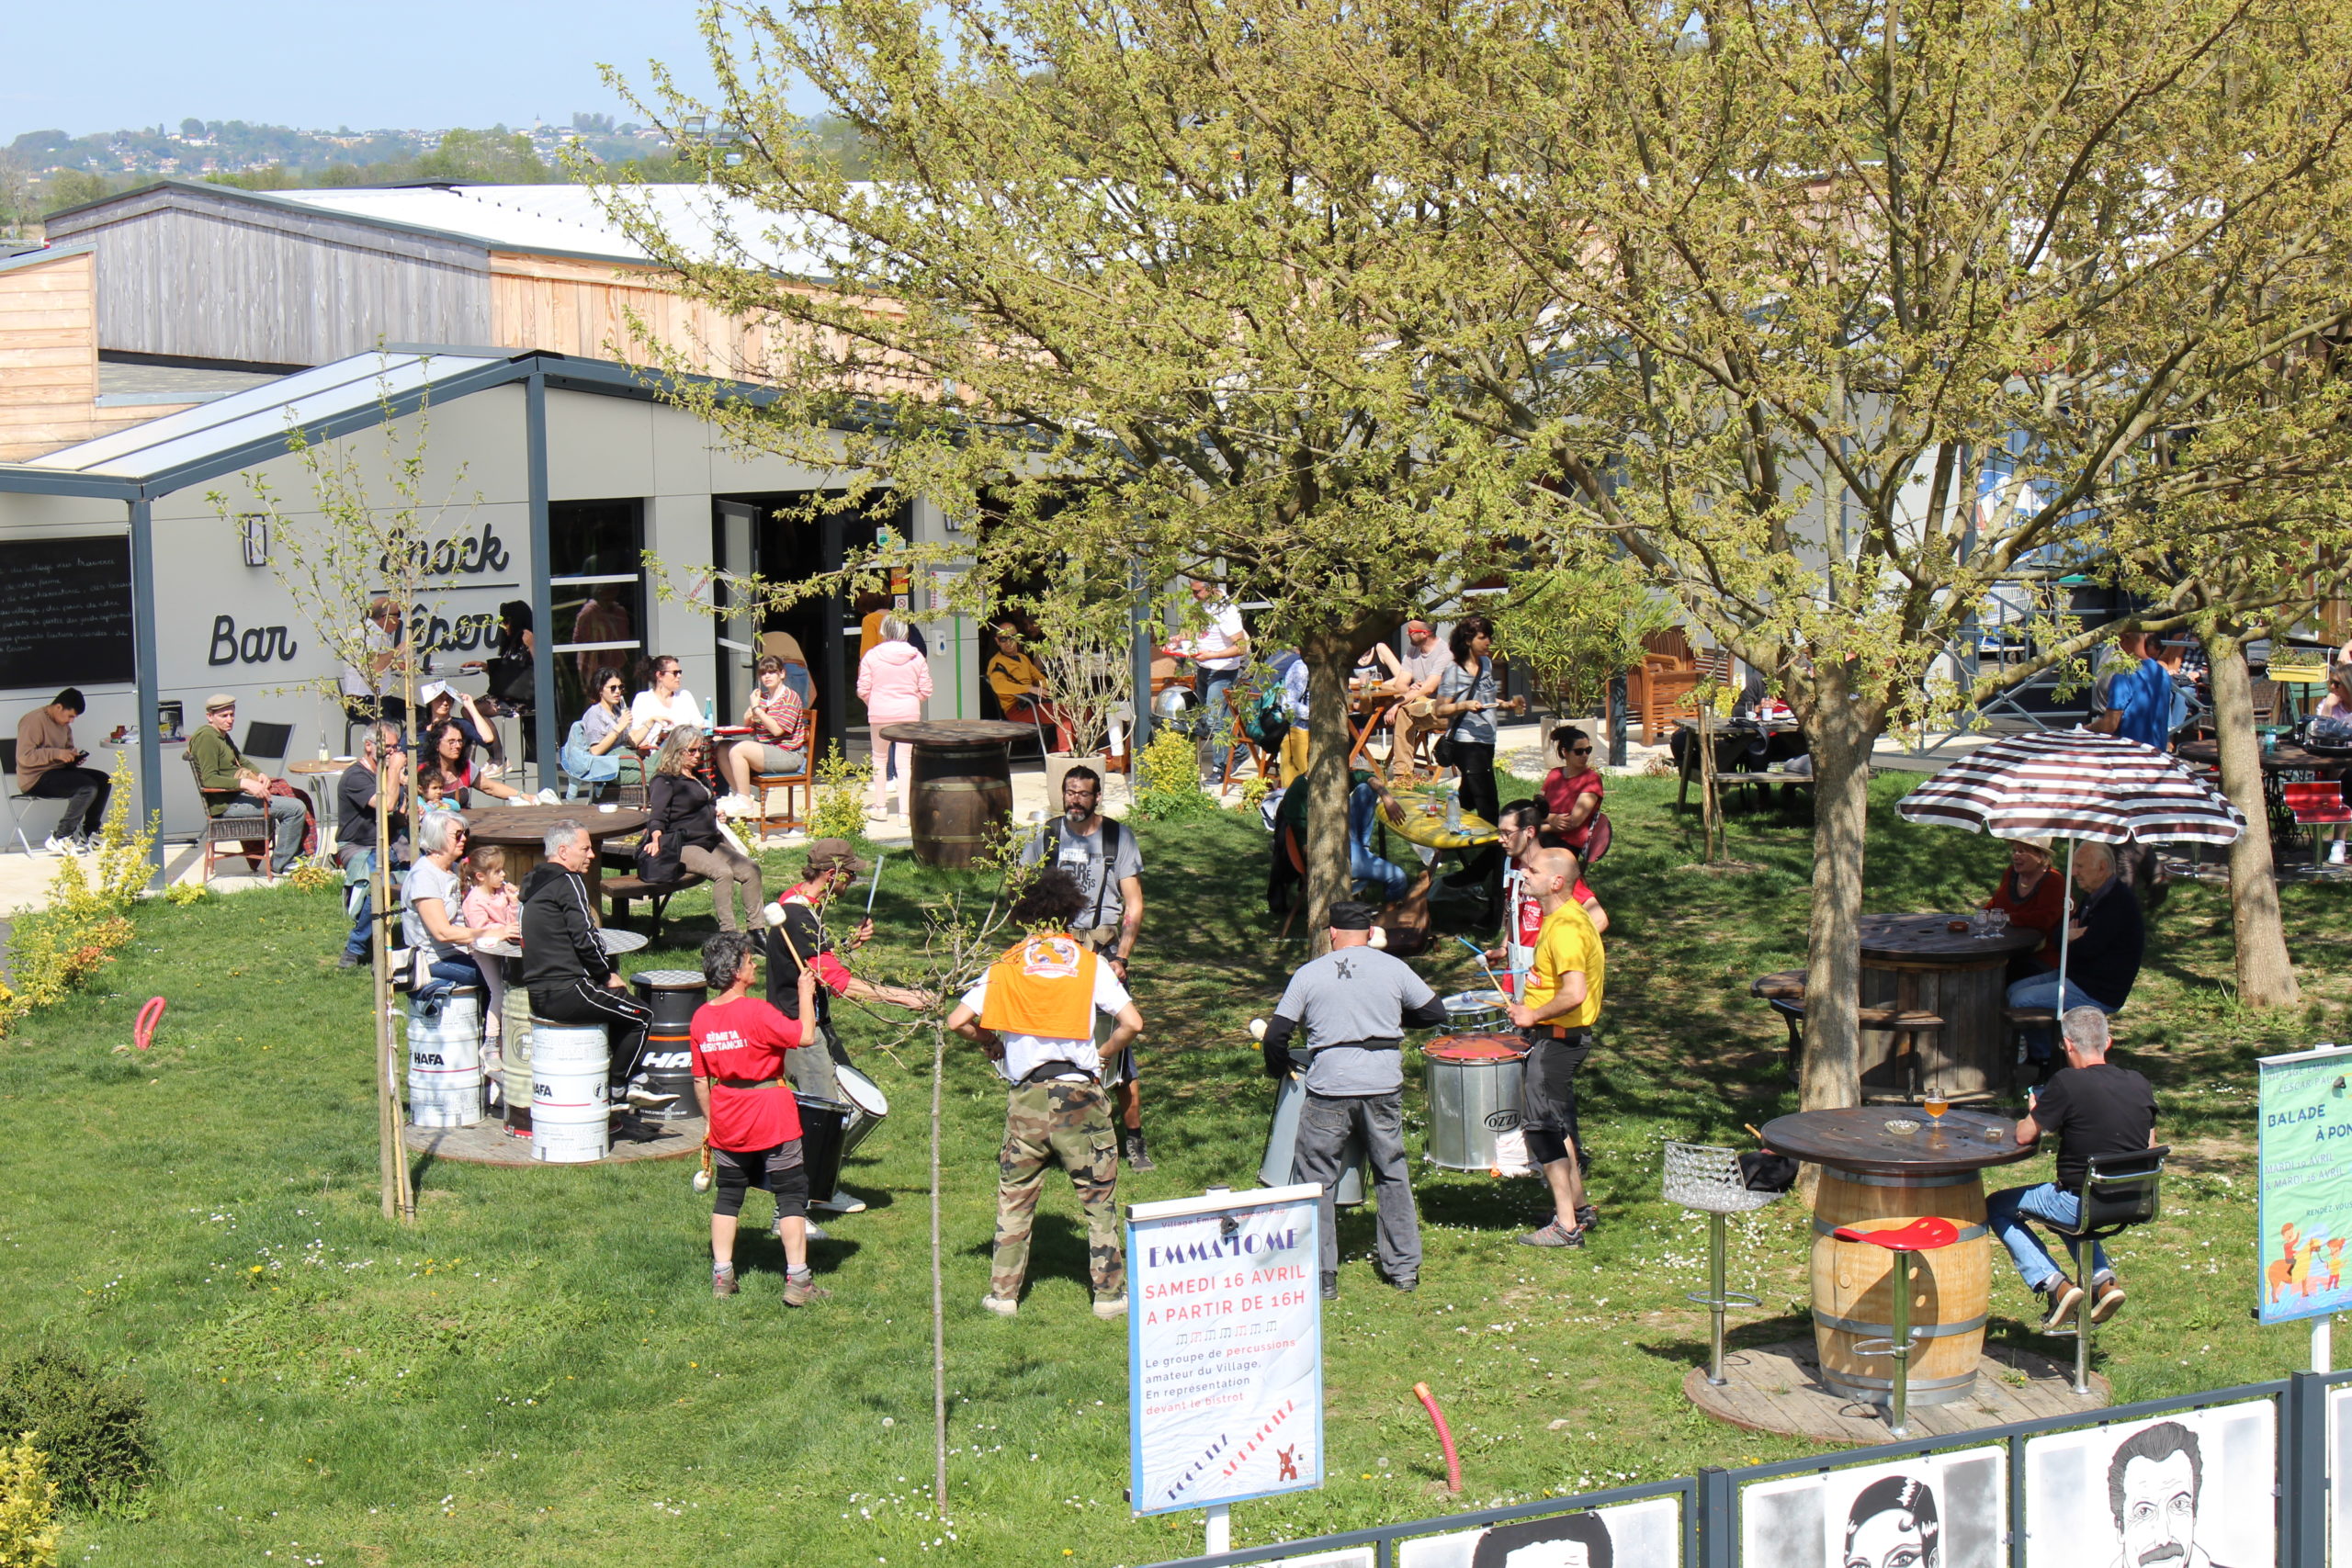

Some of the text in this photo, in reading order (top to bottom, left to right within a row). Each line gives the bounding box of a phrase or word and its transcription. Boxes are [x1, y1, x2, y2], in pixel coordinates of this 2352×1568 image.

[379, 523, 510, 576] Snack
[209, 615, 298, 666] Bar
[414, 1052, 445, 1066] HAFA
[641, 1052, 693, 1068] HA
[1488, 1112, 1519, 1128] OZZI
[2267, 1103, 2325, 1128] BALADE
[2315, 1122, 2352, 1142] À PON
[2265, 1160, 2294, 1175] MARDI
[2309, 1153, 2335, 1166] AVRIL
[2274, 1174, 2304, 1189] MARDI
[2318, 1166, 2346, 1179] AVRIL
[1161, 1219, 1193, 1229] Village
[1196, 1215, 1226, 1224] Emma
[1145, 1264, 1306, 1300] SAMEDI 16 AVRIL
[1147, 1290, 1306, 1325] A PARTIR DE 16H
[1146, 1338, 1296, 1369] Le groupe de percussions
[1145, 1369, 1193, 1384] amateur
[1197, 1366, 1212, 1376] du
[1146, 1376, 1250, 1400] En représentation
[1146, 1392, 1244, 1416] devant le bistrot
